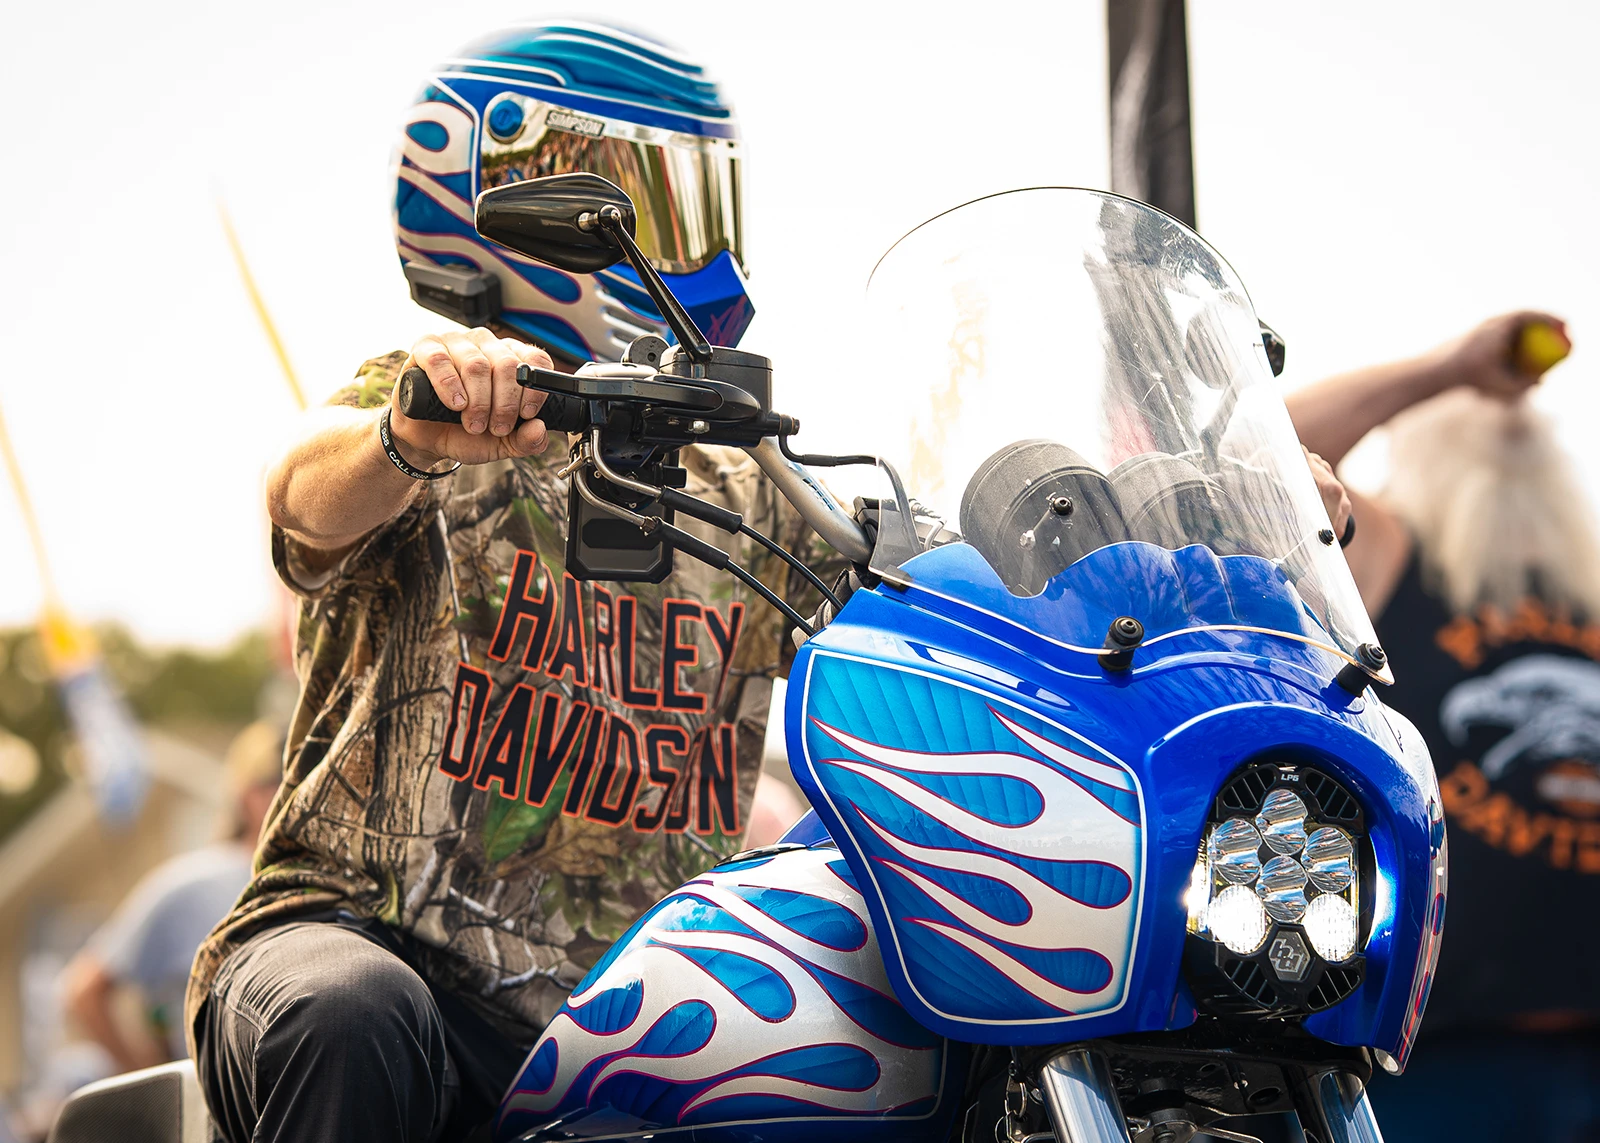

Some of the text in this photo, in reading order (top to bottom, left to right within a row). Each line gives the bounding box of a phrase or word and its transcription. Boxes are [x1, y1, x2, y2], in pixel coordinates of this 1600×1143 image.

[546, 112, 603, 135] SIMPSON
[389, 451, 410, 475] CALL
[487, 549, 746, 713] HARLEY
